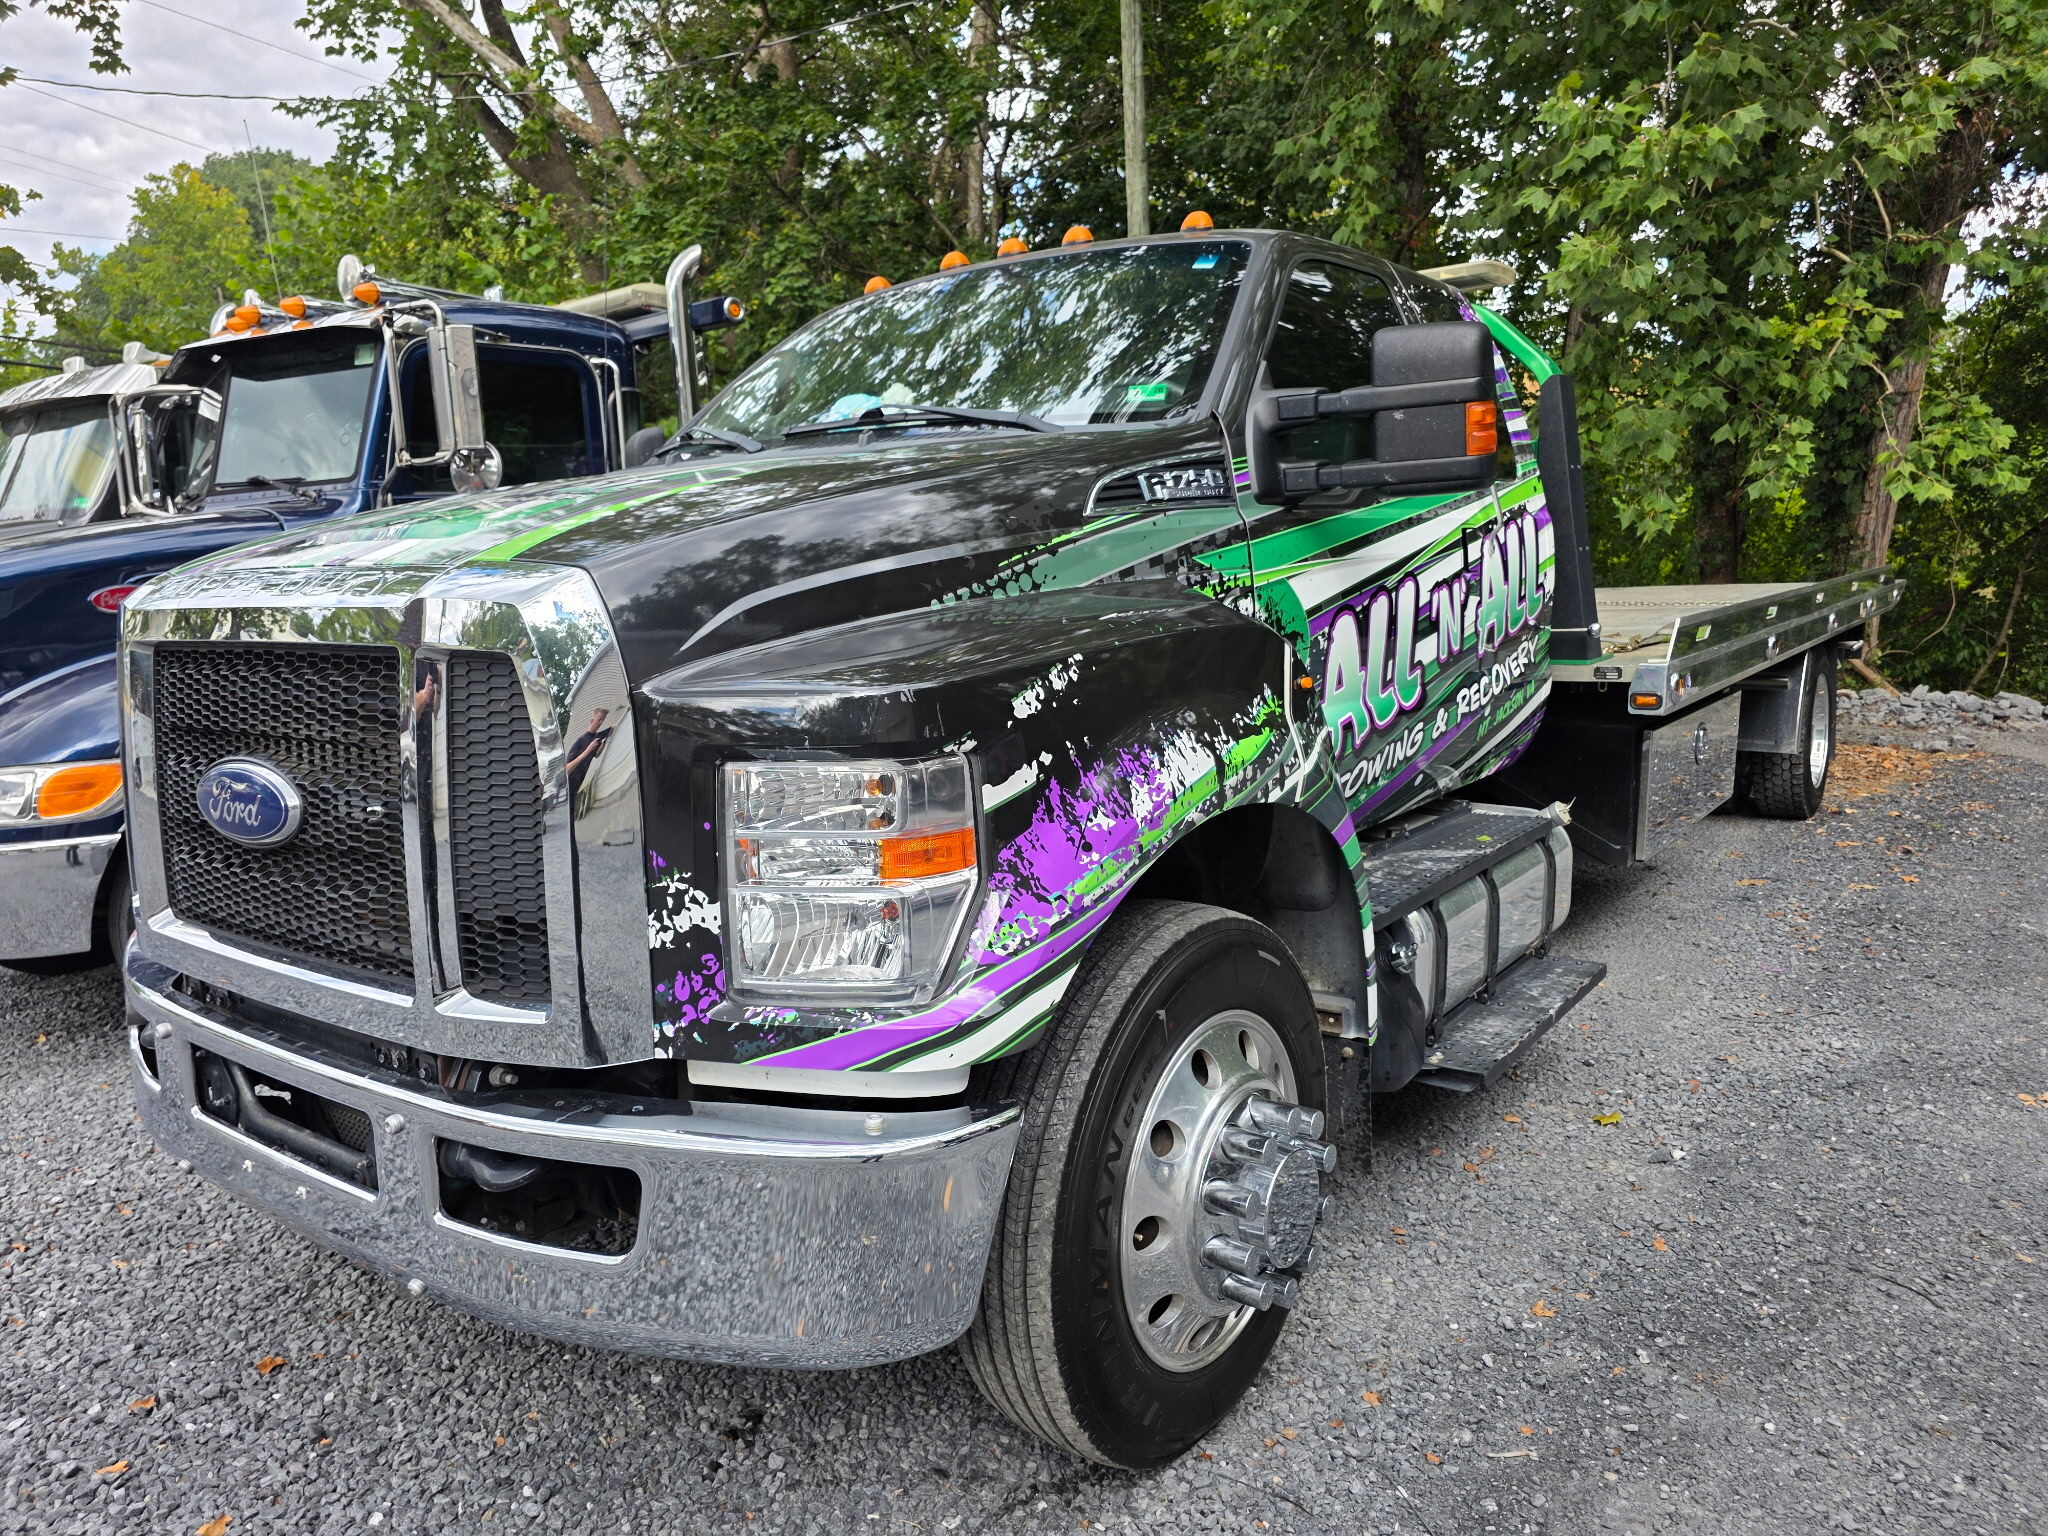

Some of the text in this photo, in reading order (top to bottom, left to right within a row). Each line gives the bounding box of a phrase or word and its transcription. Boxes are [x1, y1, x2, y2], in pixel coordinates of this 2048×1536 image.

[1321, 573, 1424, 758] ALL
[1476, 512, 1545, 658] ALL
[1432, 707, 1448, 739] &
[1456, 634, 1539, 723] RECOVERY
[209, 776, 262, 827] Ford
